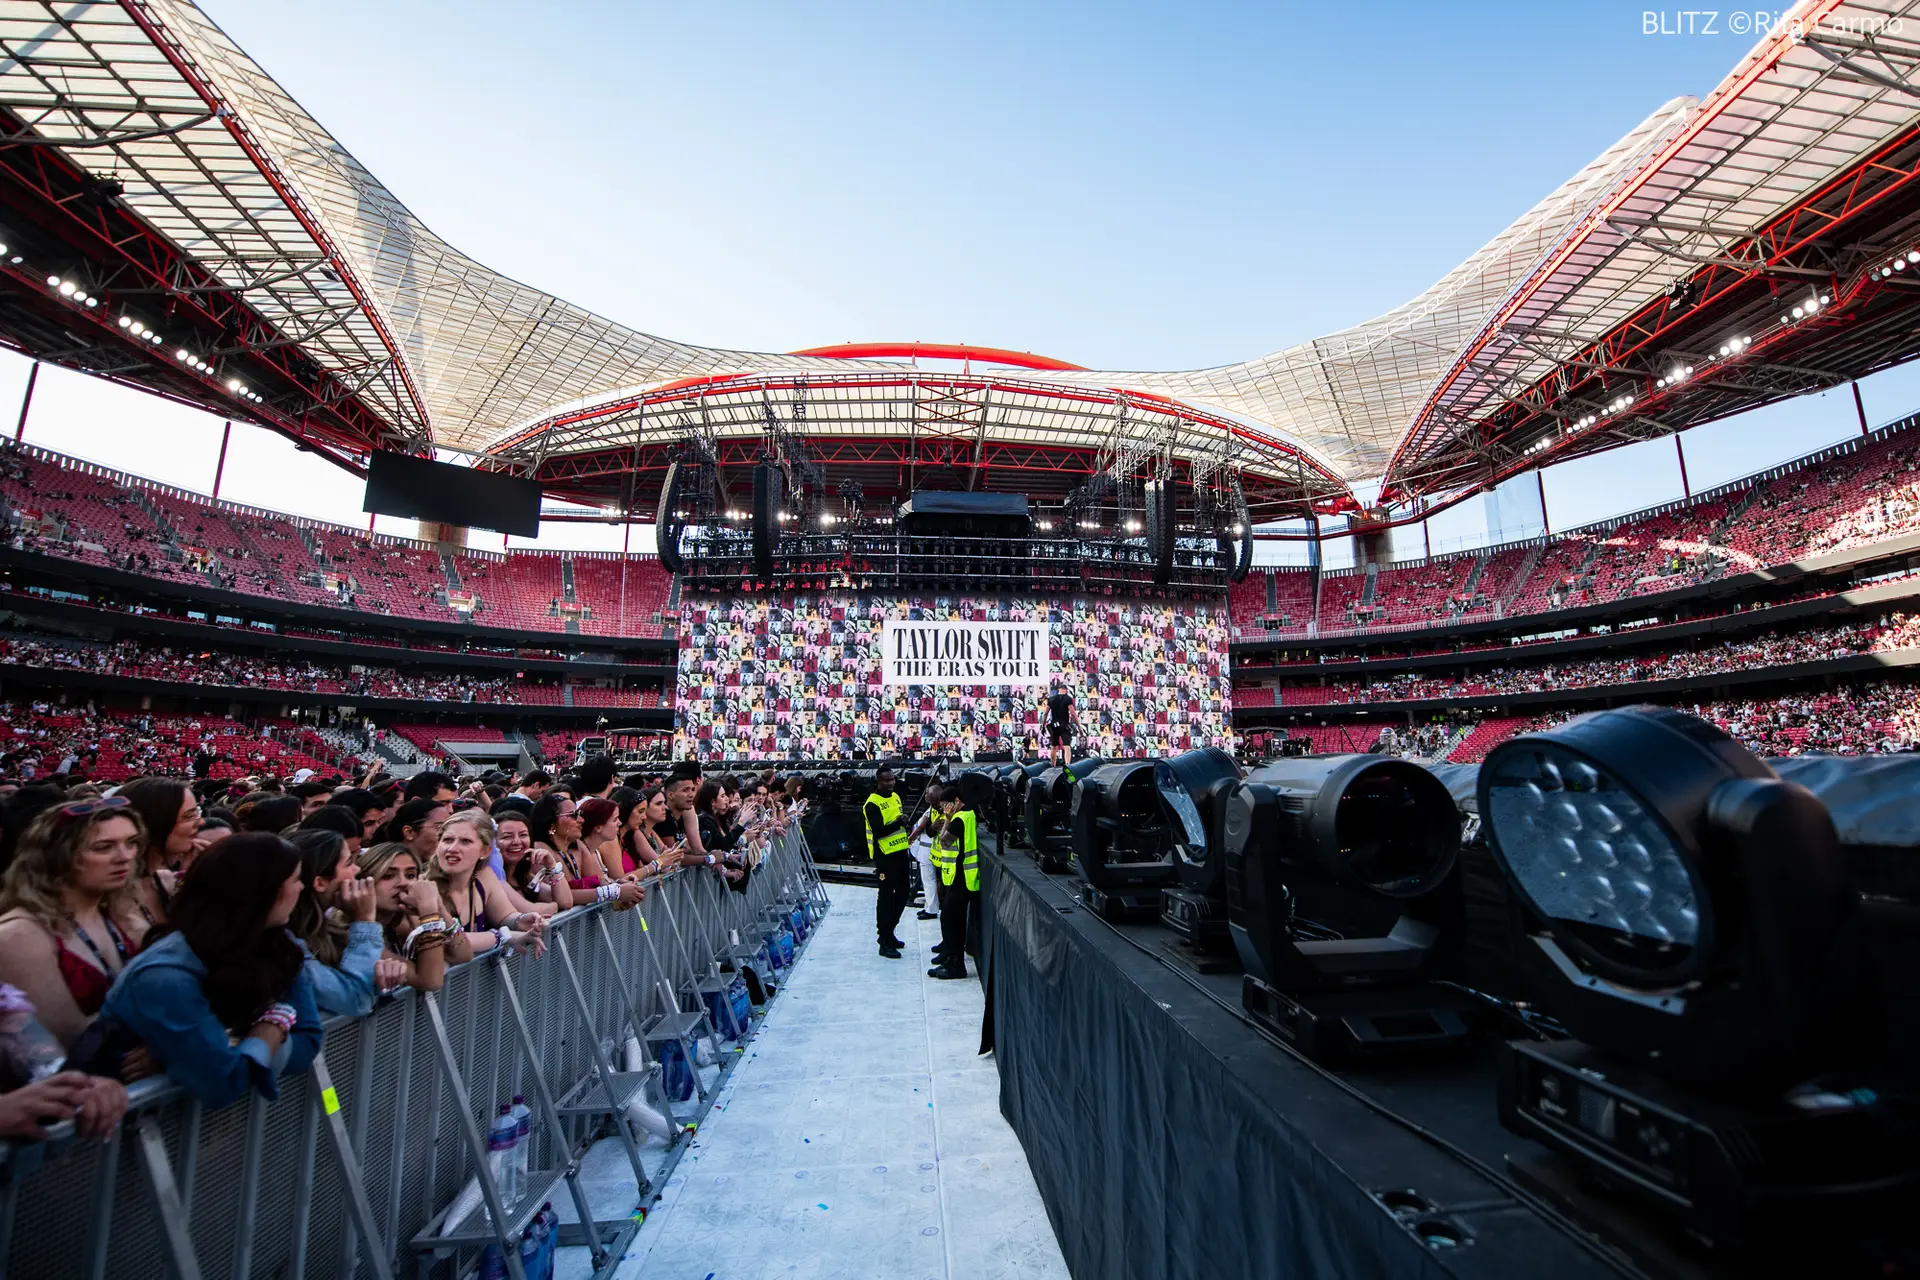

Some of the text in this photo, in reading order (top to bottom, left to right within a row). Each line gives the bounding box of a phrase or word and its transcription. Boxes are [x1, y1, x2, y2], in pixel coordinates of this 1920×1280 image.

[893, 628, 1040, 660] TAYLOR SWIFT
[893, 661, 1039, 677] THE ERAS TOUR
[889, 837, 907, 847] ASSIST
